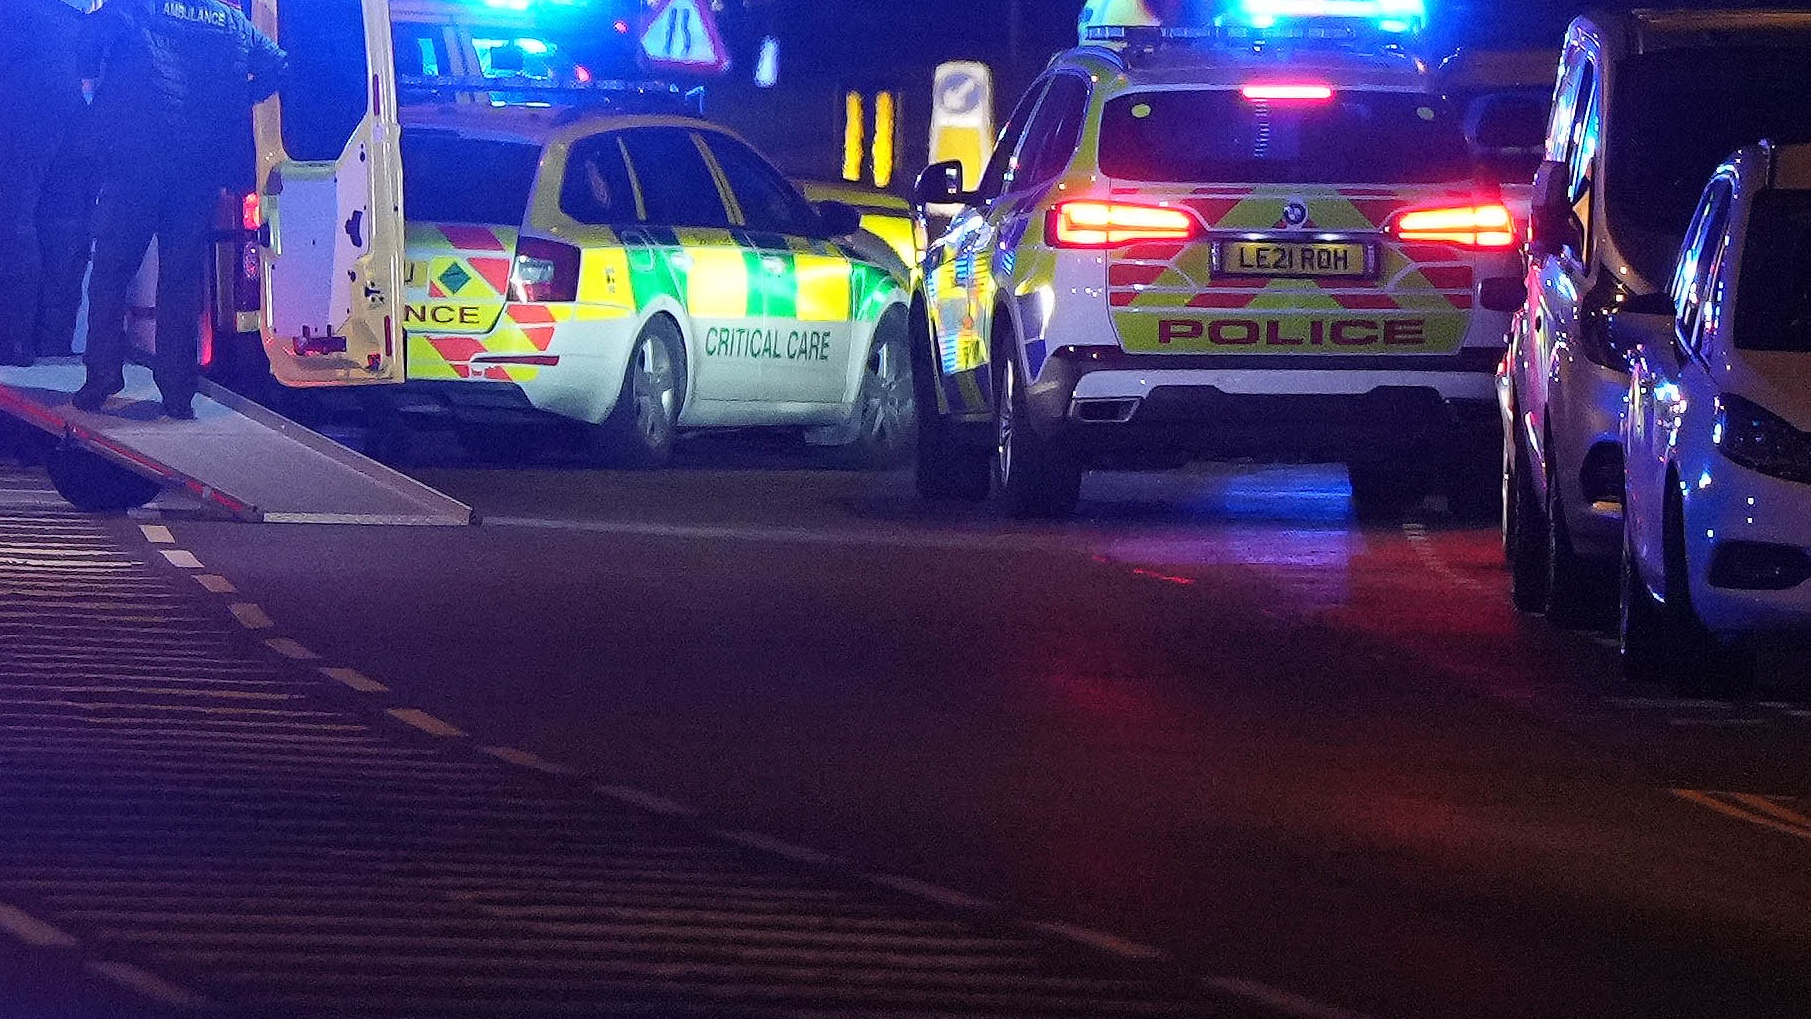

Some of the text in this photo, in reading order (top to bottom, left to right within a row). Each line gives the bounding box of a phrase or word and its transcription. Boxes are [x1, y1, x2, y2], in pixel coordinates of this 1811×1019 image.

[163, 0, 226, 27] AMBULANCE
[1239, 247, 1293, 270] LE21
[705, 327, 831, 360] CRITICAL CARE
[1158, 319, 1425, 345] POLICE
